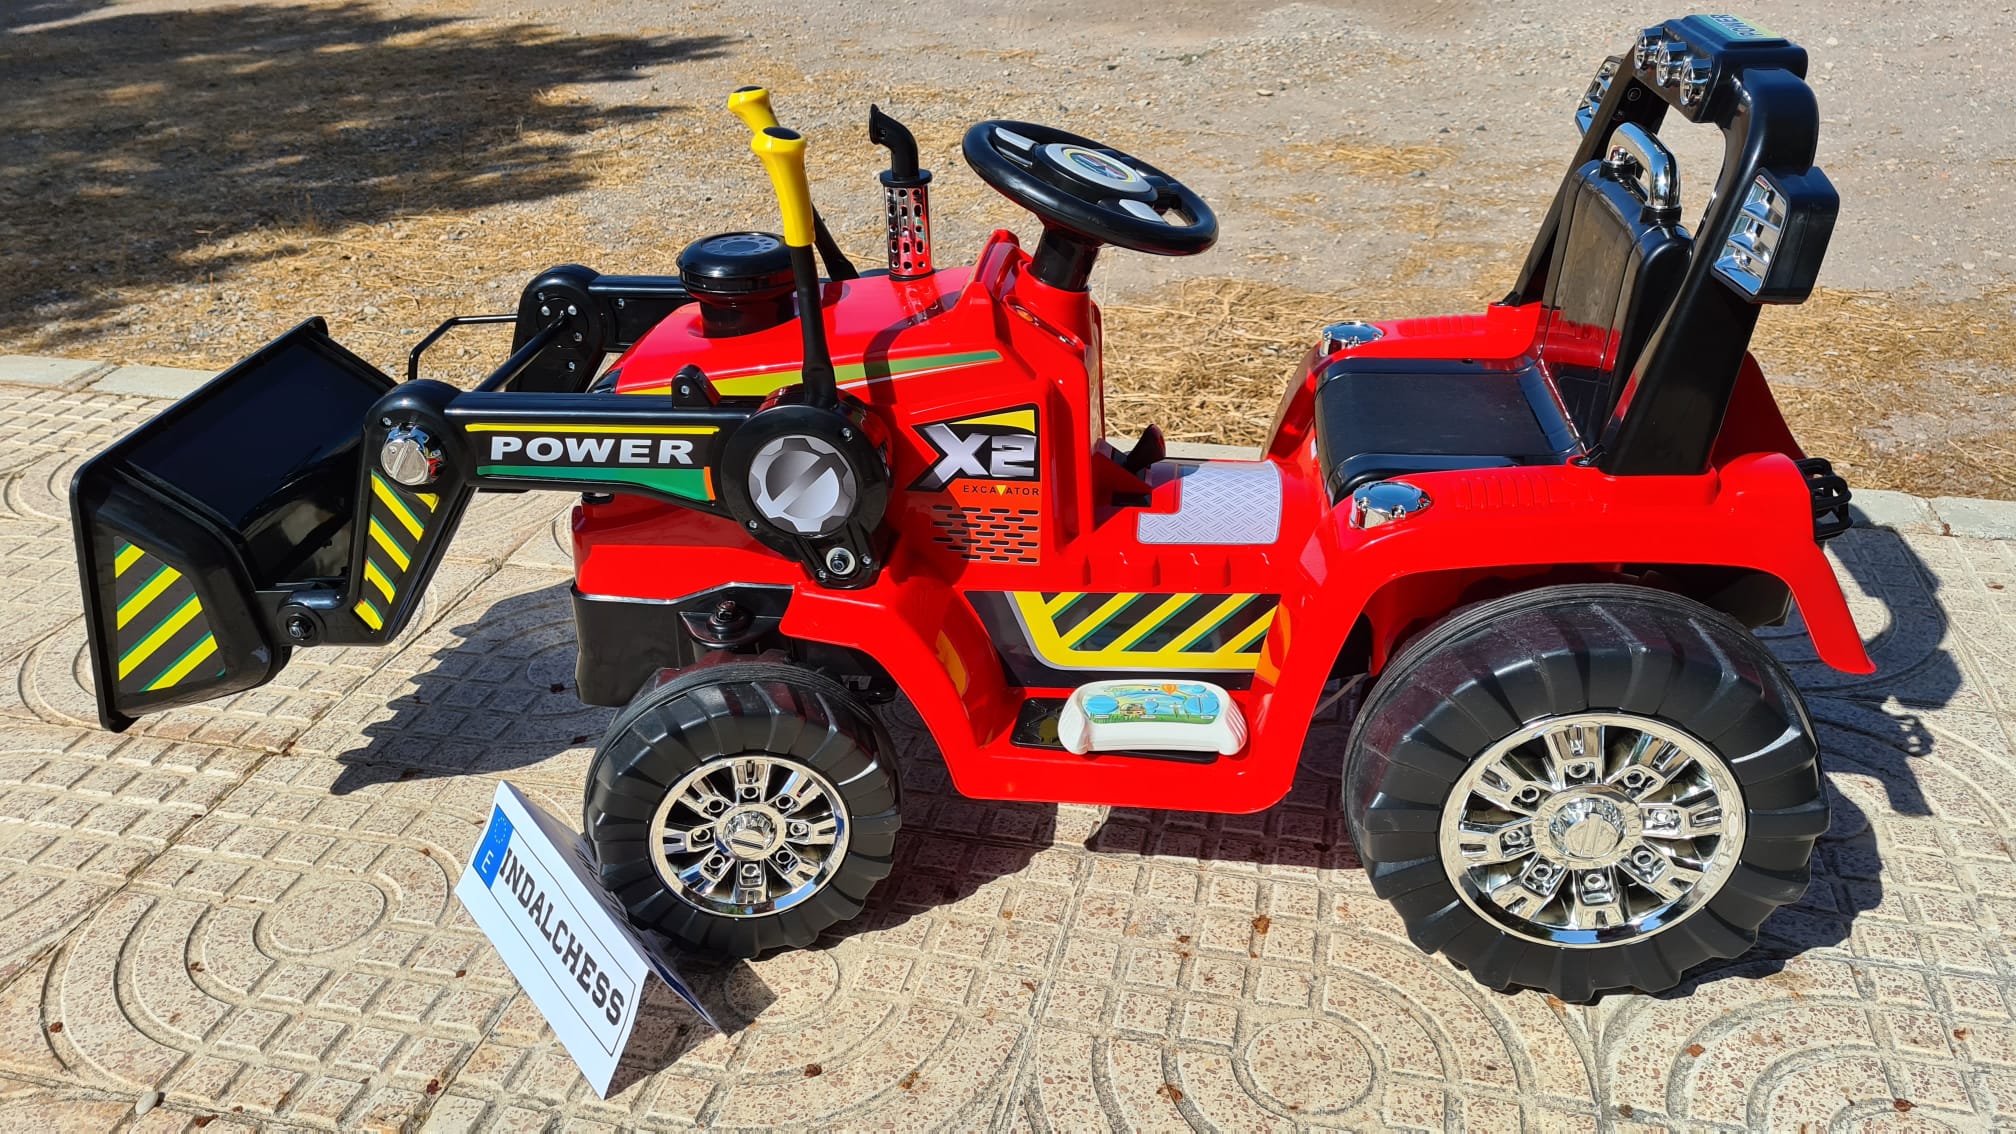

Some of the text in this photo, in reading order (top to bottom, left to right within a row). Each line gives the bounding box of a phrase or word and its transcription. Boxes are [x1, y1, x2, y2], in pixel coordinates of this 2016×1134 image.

[490, 436, 694, 465] POWER
[918, 423, 1037, 489] X2
[480, 847, 625, 1027] E INDALCHESS
